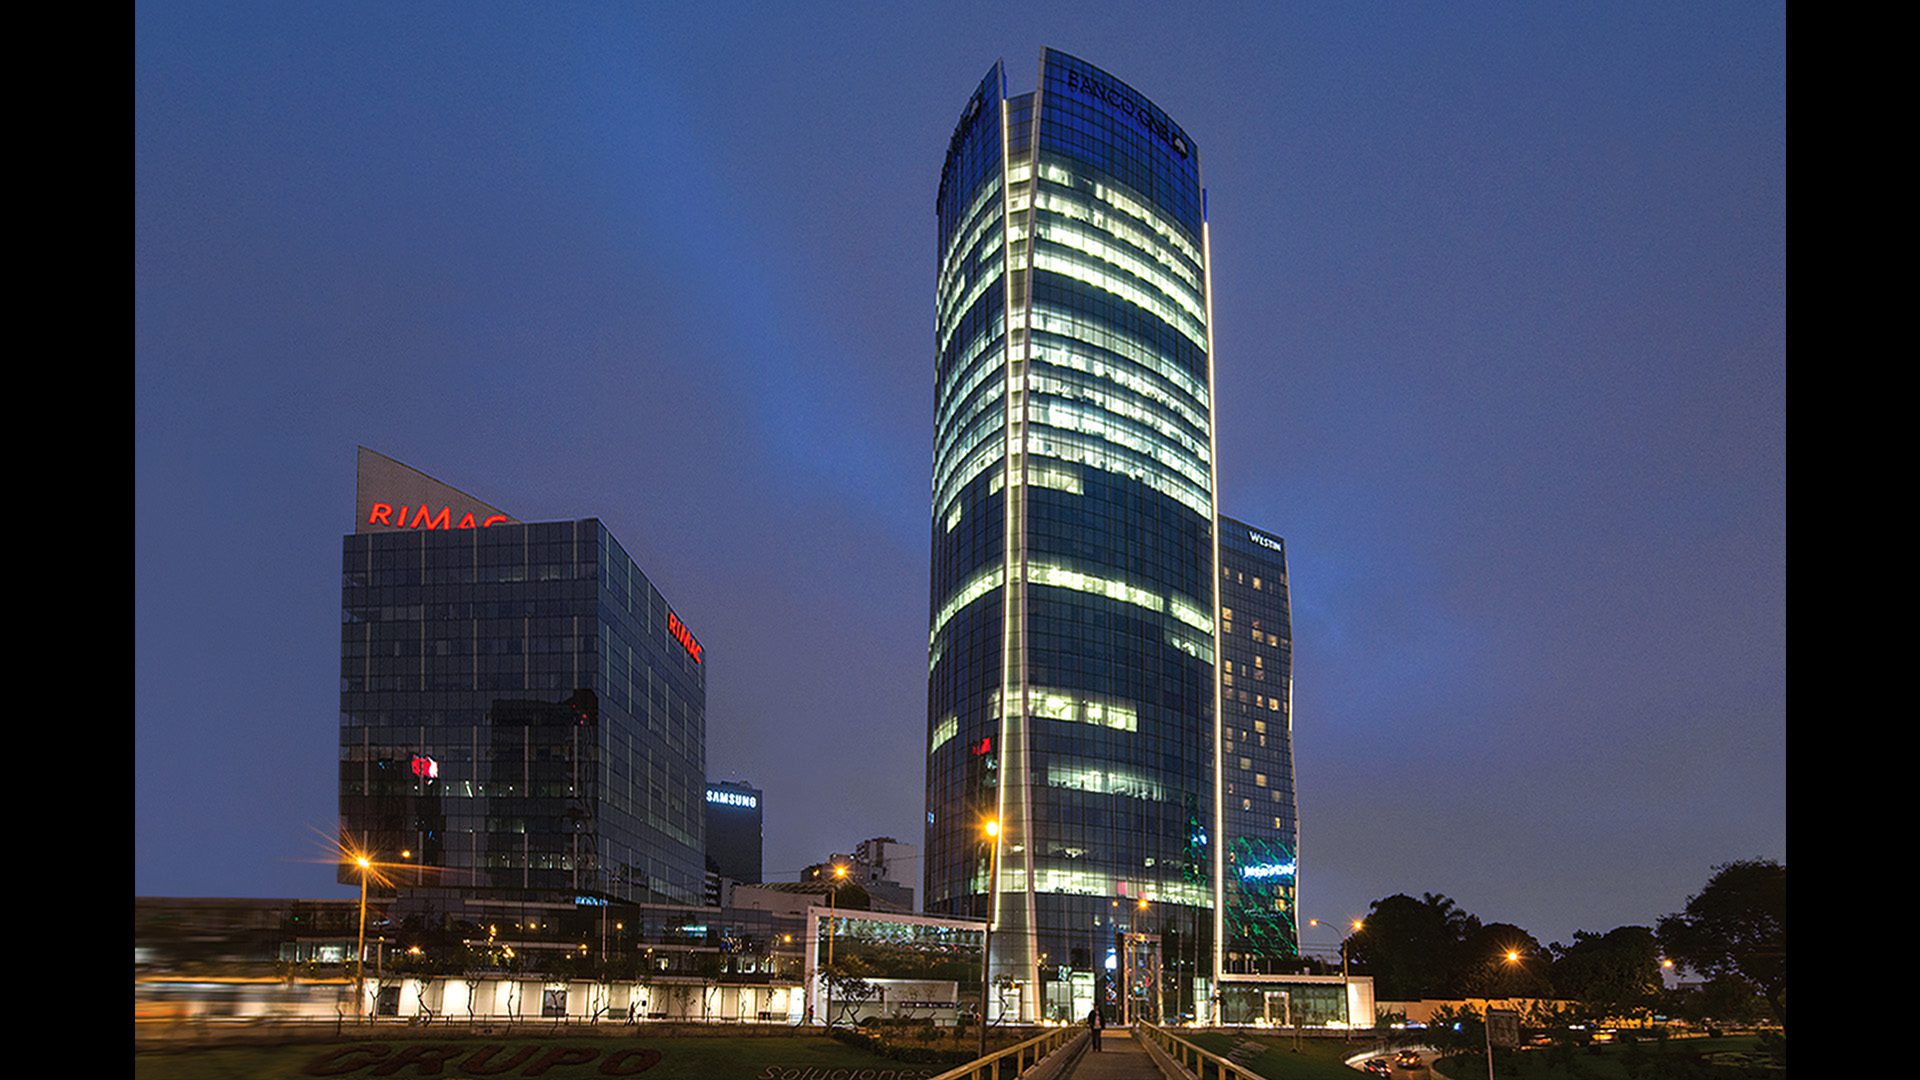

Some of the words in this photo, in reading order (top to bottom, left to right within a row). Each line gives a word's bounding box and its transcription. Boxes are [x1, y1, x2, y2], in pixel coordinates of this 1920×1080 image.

[1067, 69, 1135, 117] BANCO
[669, 611, 702, 664] RIMAC
[706, 790, 757, 808] SAMSUNG
[303, 1043, 663, 1077] GRUPO
